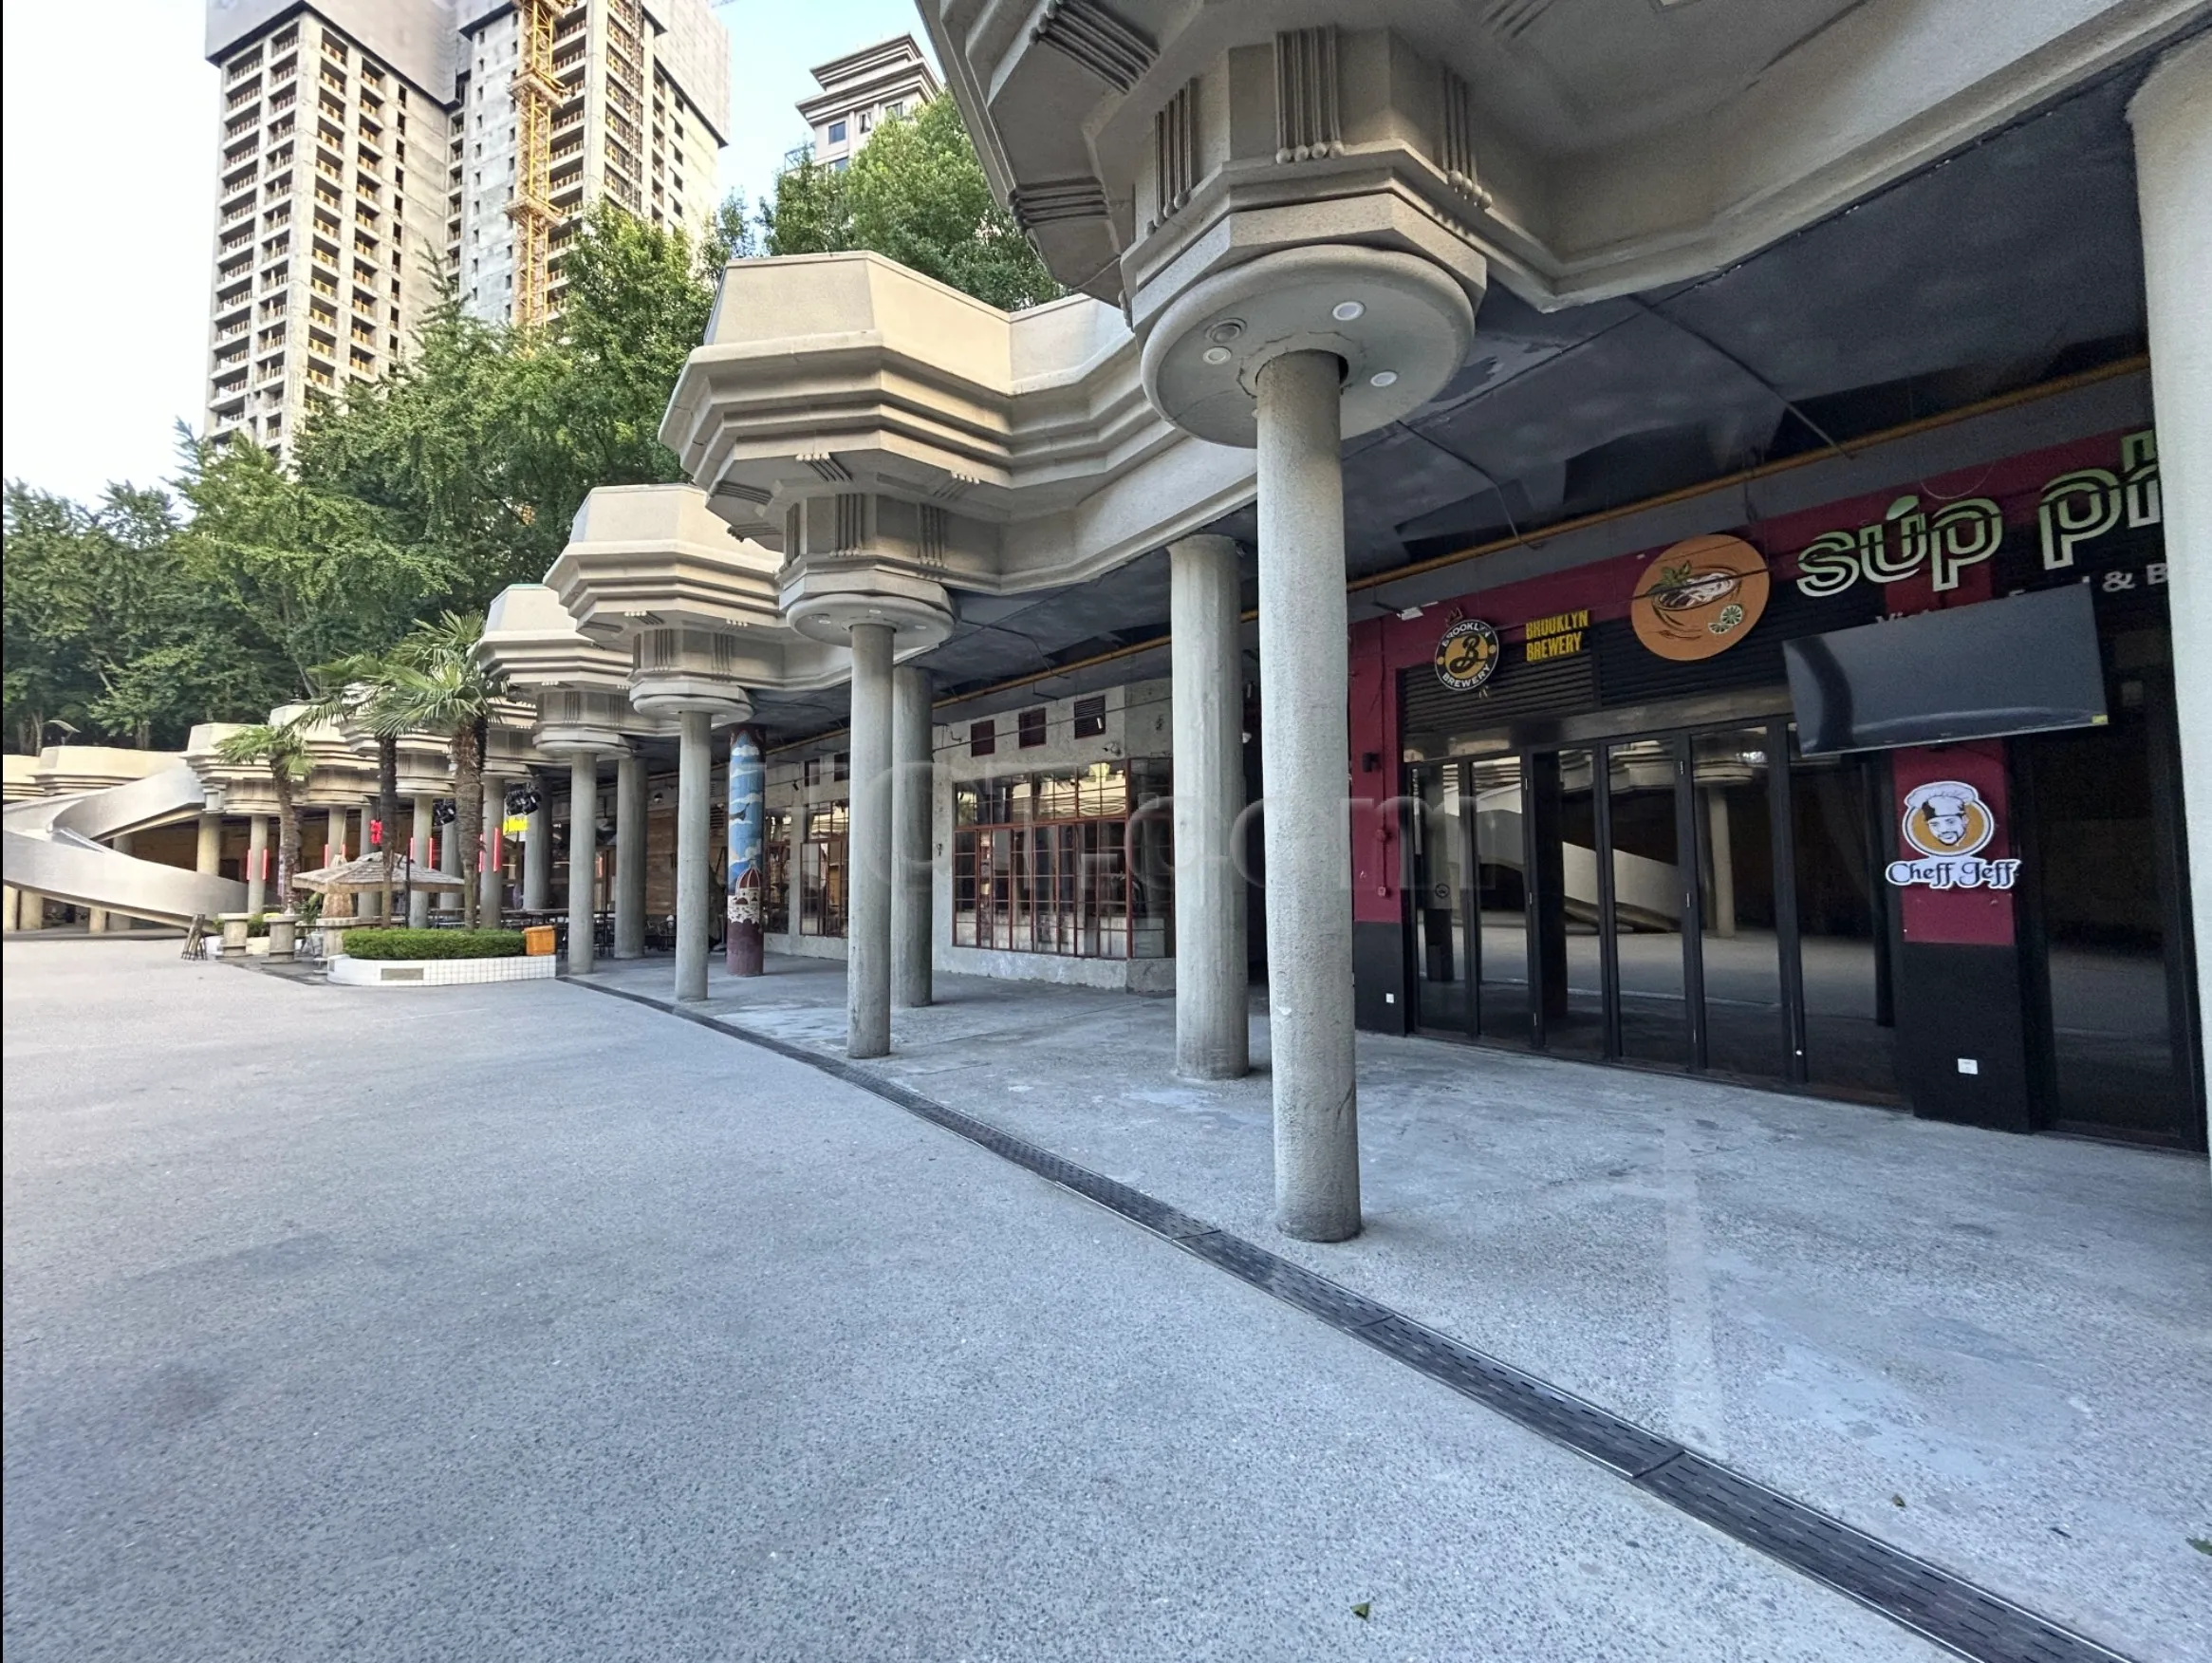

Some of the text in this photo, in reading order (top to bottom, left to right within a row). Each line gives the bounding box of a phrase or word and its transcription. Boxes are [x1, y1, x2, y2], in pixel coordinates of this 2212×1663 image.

[1526, 609, 1589, 640] BROOKLYN
[1526, 630, 1583, 662] BREWERY
[1441, 663, 1491, 688] BREWERY
[1887, 861, 1956, 888] Cheff
